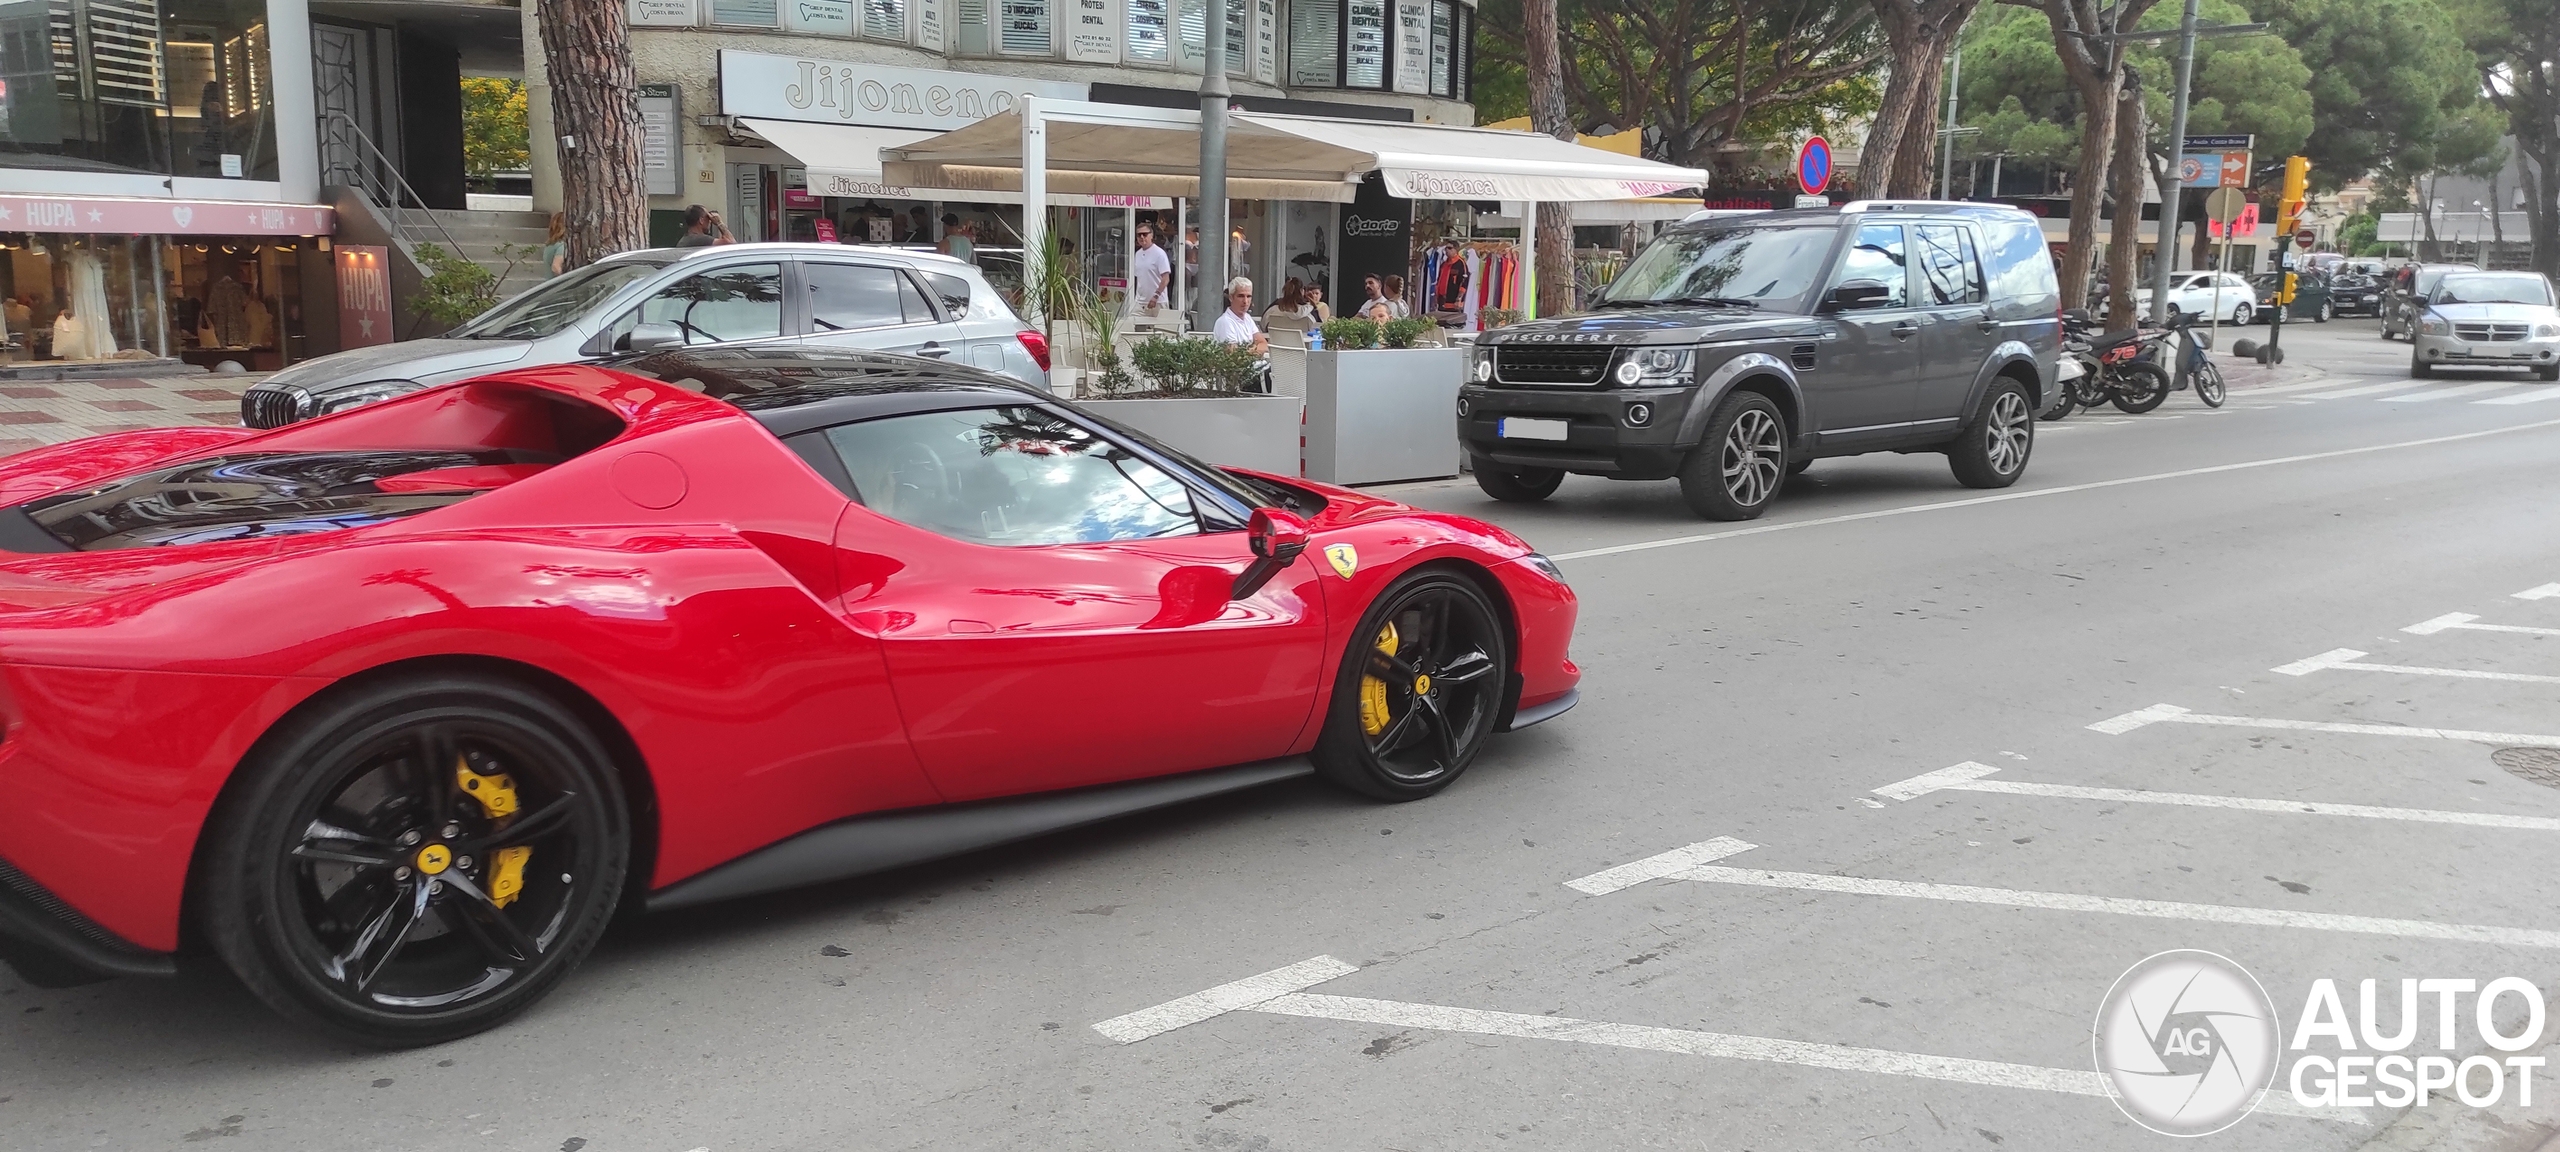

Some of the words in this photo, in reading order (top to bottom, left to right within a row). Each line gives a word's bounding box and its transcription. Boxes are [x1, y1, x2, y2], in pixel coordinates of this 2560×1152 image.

[1400, 4, 1426, 17] CLINICA
[1014, 21, 1038, 30] BUCALS
[1082, 15, 1104, 25] DENTAL
[1352, 17, 1380, 27] DENTAL
[785, 61, 1036, 119] Jijonenc
[701, 171, 711, 180] 91
[1406, 171, 1497, 197] Jijonenca
[26, 202, 77, 227] HUPA
[262, 209, 285, 230] HUPA
[1360, 219, 1399, 231] doria
[342, 267, 386, 312] HUPA
[1500, 334, 1617, 342] DISCOVERY
